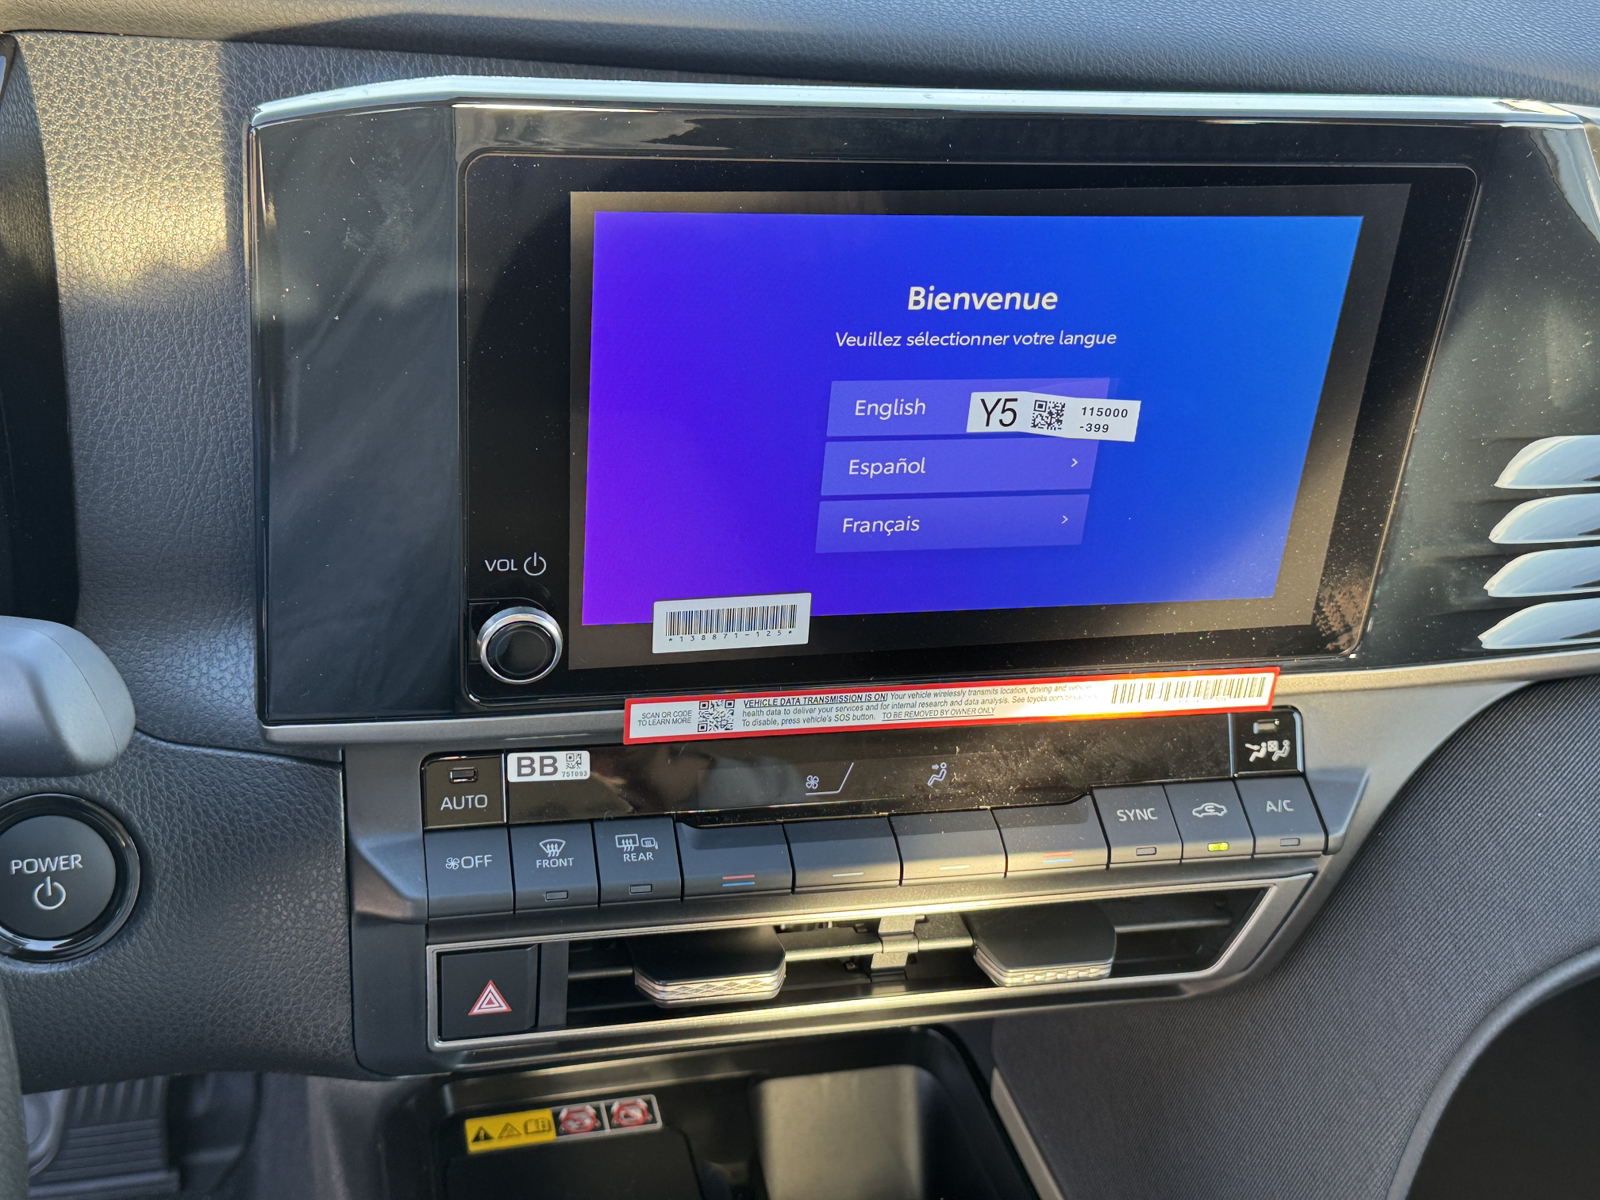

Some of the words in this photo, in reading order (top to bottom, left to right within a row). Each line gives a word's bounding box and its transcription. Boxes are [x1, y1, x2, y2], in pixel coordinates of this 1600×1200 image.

[907, 285, 1058, 311] Bienvenue
[835, 332, 902, 347] Veuillez
[906, 331, 1009, 346] sélectionner
[1013, 331, 1055, 346] votre
[1059, 330, 1117, 348] langue
[854, 398, 926, 420] English
[979, 397, 1019, 427] Y5
[1080, 406, 1129, 418] 115000
[1079, 423, 1110, 433] -399
[848, 457, 926, 479] Español
[842, 515, 920, 536] Français
[484, 559, 518, 572] VOL
[744, 698, 778, 707] VEHICLE
[780, 697, 800, 706] DATA
[803, 694, 863, 705] TRANSMISSION
[874, 692, 888, 701] ON!
[890, 692, 906, 700] Your
[908, 691, 932, 699] vehicle
[933, 689, 966, 698] wirelessly
[968, 687, 998, 697] transmits
[1000, 685, 1028, 695] location,
[1029, 685, 1053, 695] driving
[1053, 683, 1067, 692] and
[642, 711, 660, 719] SCAN
[673, 709, 692, 718] CODE
[742, 709, 764, 718] health
[766, 708, 781, 717] data
[784, 707, 790, 716] to
[793, 706, 817, 715] deliver
[818, 706, 833, 715] your
[835, 704, 864, 713] services
[866, 703, 879, 712] and
[880, 702, 890, 711] for
[892, 701, 917, 710] internal
[918, 699, 948, 709] research
[950, 699, 962, 707] and
[964, 697, 979, 706] data
[1012, 695, 1025, 704] See
[638, 719, 647, 727] TO
[648, 719, 671, 727] LEARN
[672, 717, 692, 725] MORE
[742, 719, 750, 727] To
[752, 717, 779, 727] disable,
[781, 717, 800, 727] press
[803, 715, 832, 724] vehicle's
[834, 713, 850, 722] SOS
[852, 712, 876, 722] button.
[882, 711, 892, 719] TO
[904, 708, 939, 718] REMOVED
[940, 708, 950, 717] BY
[950, 706, 977, 716] OWNER
[978, 706, 996, 715] ONLY
[517, 755, 558, 777] BB
[440, 794, 488, 811] AUTO
[1266, 799, 1295, 813] A/C
[1117, 807, 1158, 822] SYNC
[11, 853, 83, 875] POWER
[460, 854, 493, 869] OFF
[536, 857, 575, 869] FRONT
[623, 851, 654, 863] REAR
